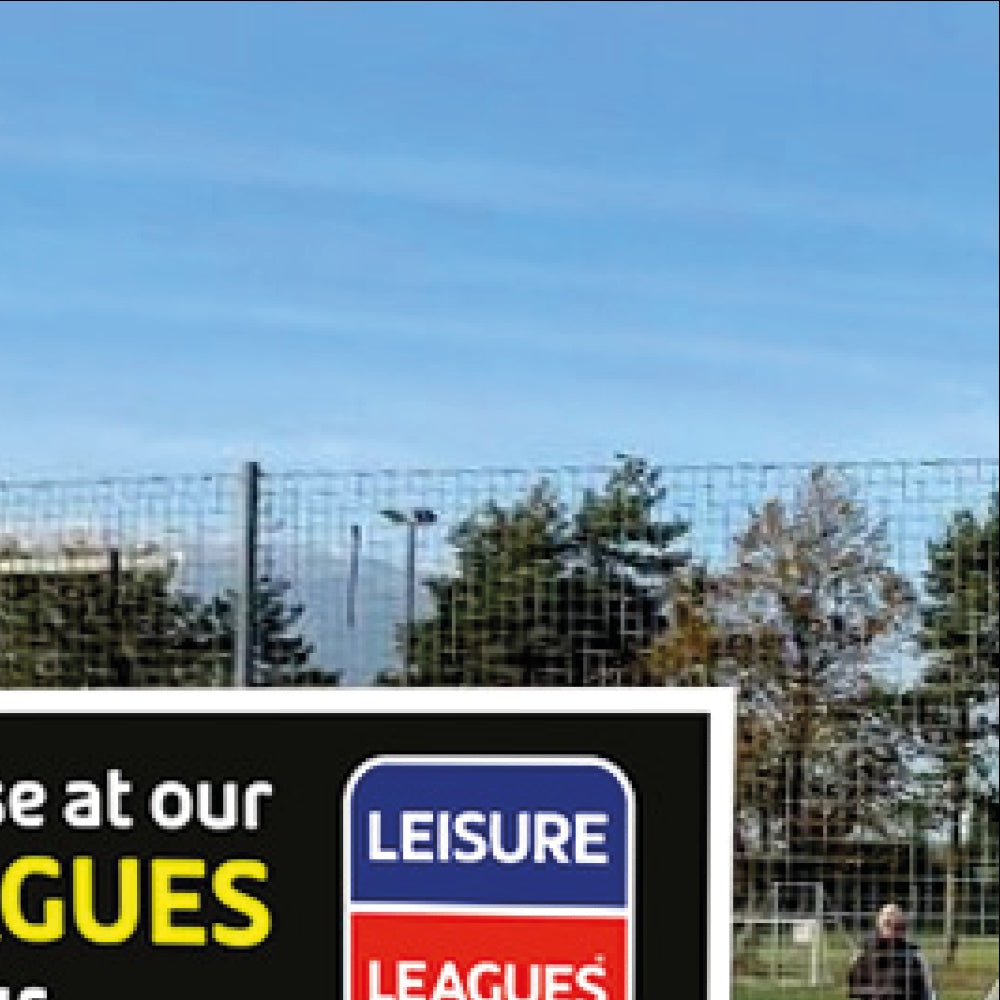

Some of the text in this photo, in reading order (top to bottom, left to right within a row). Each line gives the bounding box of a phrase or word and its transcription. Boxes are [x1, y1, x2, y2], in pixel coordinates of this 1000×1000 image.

[62, 769, 134, 829] at
[152, 781, 273, 829] our
[368, 811, 609, 863] LEISURE
